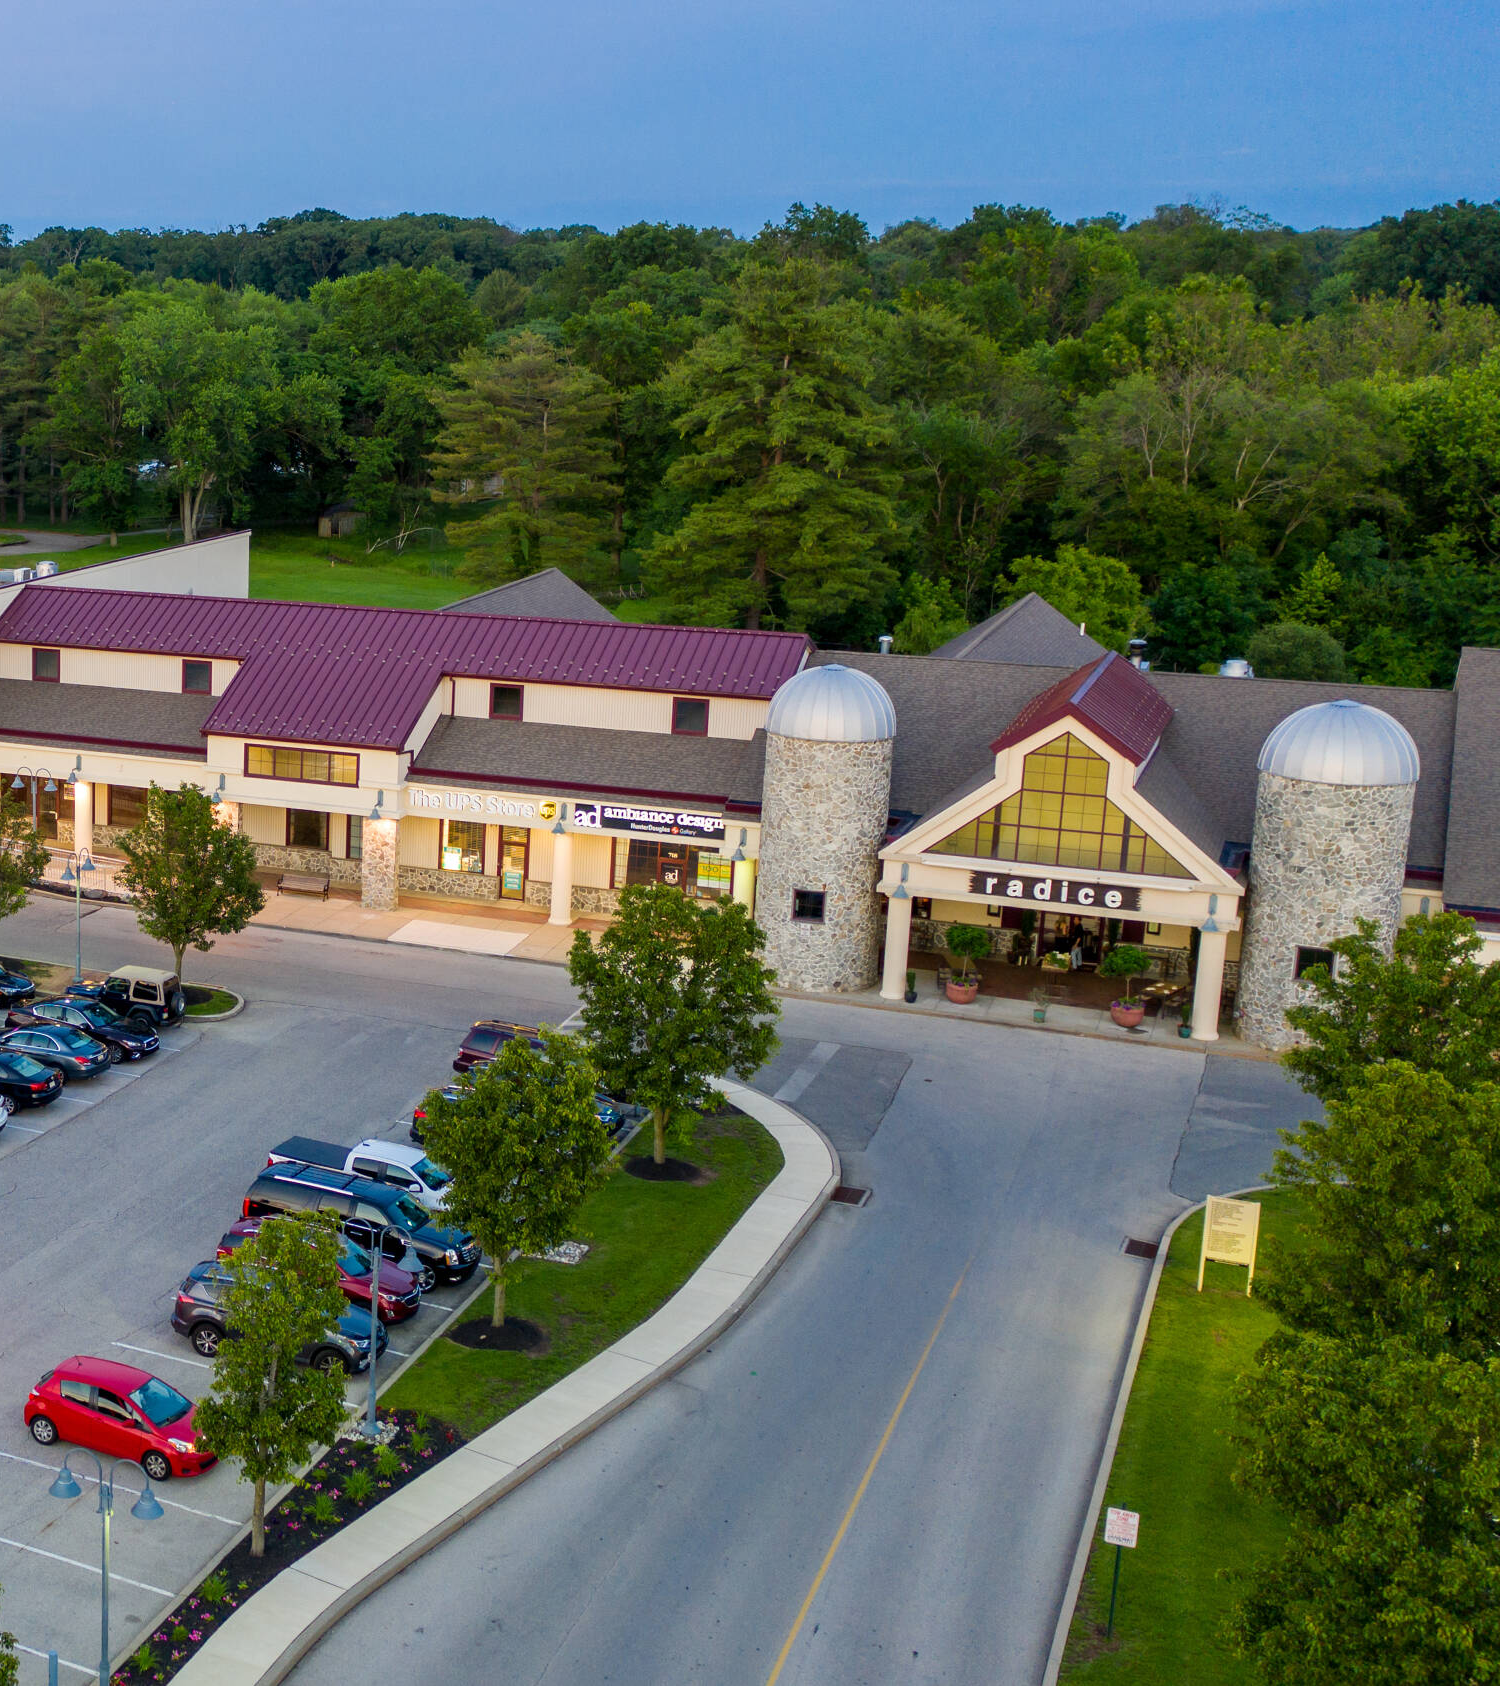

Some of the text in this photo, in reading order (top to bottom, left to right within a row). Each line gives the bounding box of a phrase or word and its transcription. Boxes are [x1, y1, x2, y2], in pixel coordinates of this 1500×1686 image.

[408, 789, 535, 818] The UPS Store
[574, 805, 602, 828] ad
[603, 807, 724, 832] ambiance design
[985, 877, 1123, 908] radice
